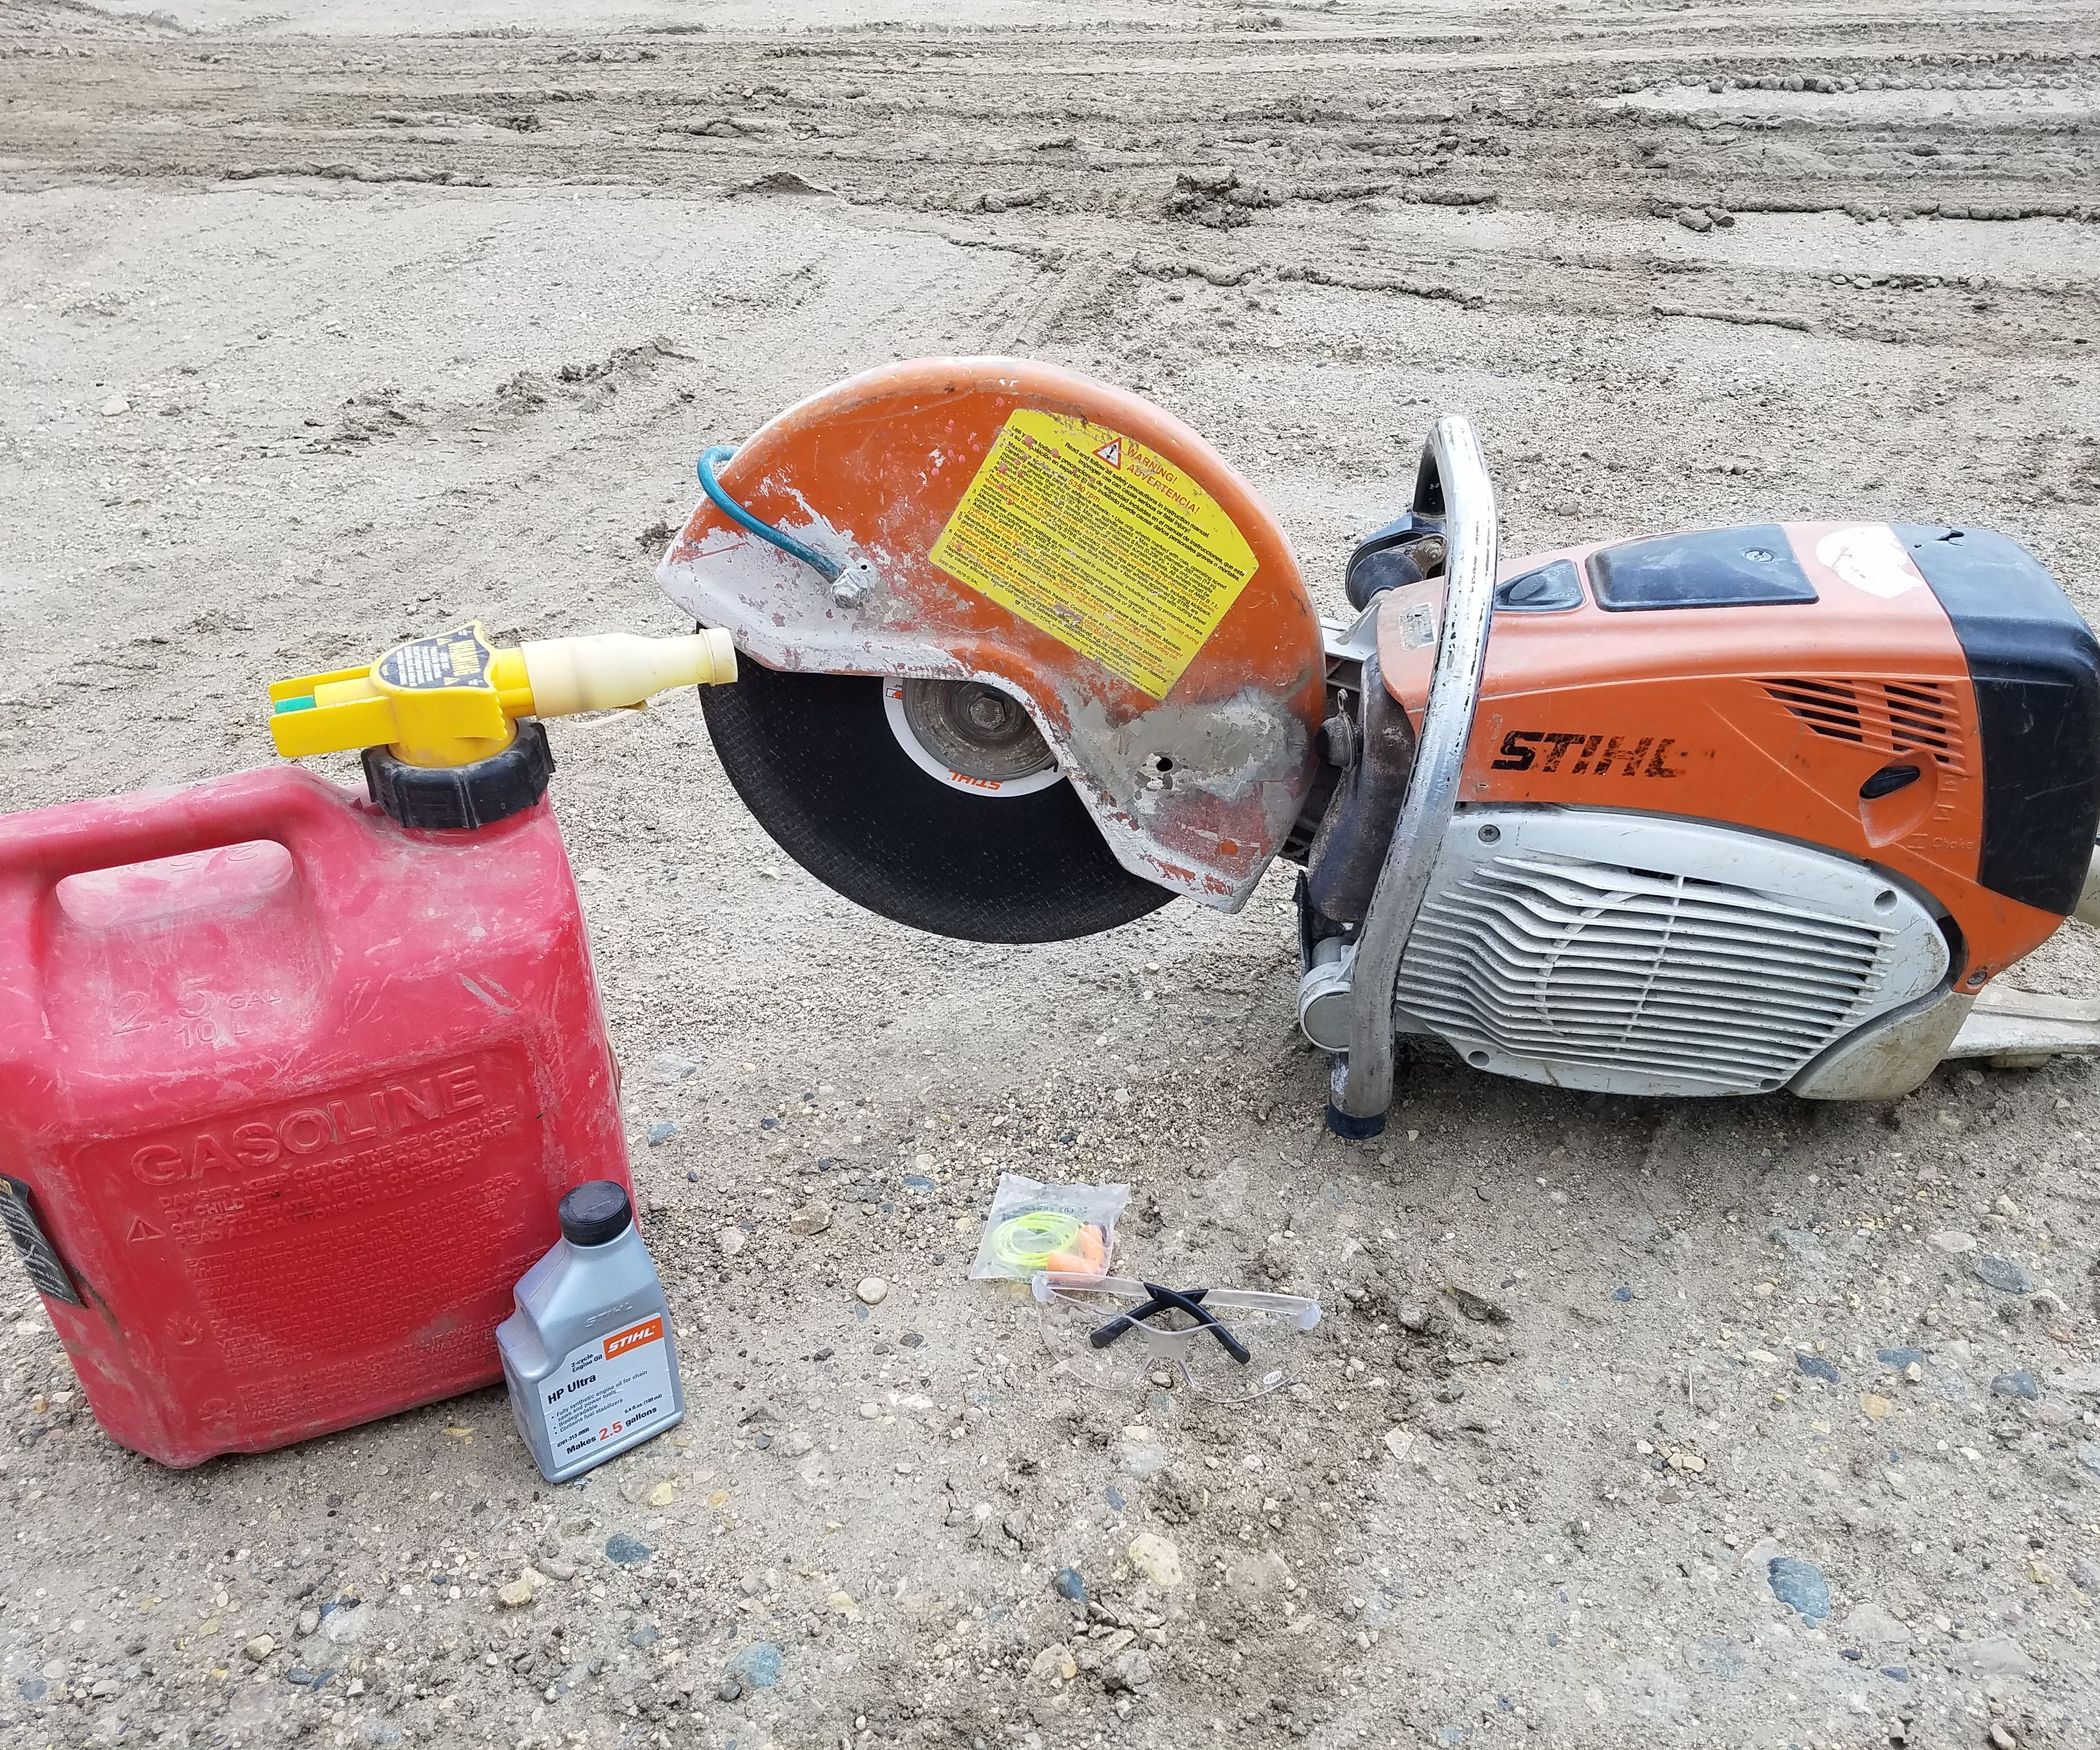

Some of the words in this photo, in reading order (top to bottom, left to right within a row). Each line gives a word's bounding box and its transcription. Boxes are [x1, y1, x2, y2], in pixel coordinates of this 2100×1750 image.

[1127, 446, 1178, 485] WARNING!
[1064, 442, 1079, 454] Read
[1078, 451, 1089, 461] and
[1088, 458, 1106, 471] follow
[1104, 467, 1113, 476] all
[1111, 472, 1128, 485] safety
[1127, 482, 1158, 505] precautions
[1163, 505, 1191, 525] instruction
[1077, 458, 1101, 476] Improper
[1101, 473, 1112, 483] use
[1111, 480, 1121, 489] can
[1121, 486, 1138, 499] cause
[1137, 496, 1157, 511] serious
[1162, 512, 1174, 523] fatal
[1173, 520, 1190, 533] injury!
[1126, 463, 1201, 515] ADVERTENCIA!
[947, 768, 1004, 791] STIHL
[131, 1065, 484, 1186] GASOLINE
[460, 1120, 511, 1147] START
[242, 1172, 290, 1190] KEEP
[293, 1162, 328, 1181] OUT
[333, 1155, 356, 1171] OF
[358, 1144, 395, 1161] THE
[395, 1126, 452, 1149] REACH
[608, 1328, 655, 1354] STIHL
[571, 1353, 594, 1368] 2-cycle
[572, 1360, 593, 1373] Engine
[593, 1354, 603, 1362] Oil
[547, 1388, 565, 1405] HP
[567, 1374, 597, 1393] Ultra
[556, 1407, 569, 1418] Fully
[569, 1393, 594, 1409] synthetic
[595, 1386, 615, 1398] engine
[623, 1376, 632, 1384] for
[632, 1370, 648, 1380] chain
[557, 1411, 572, 1422] saws
[572, 1405, 584, 1414] and
[584, 1397, 602, 1410] power
[558, 1404, 598, 1427] Biodegradable
[560, 1417, 583, 1433] Contains
[583, 1411, 594, 1420] fuel
[595, 1398, 624, 1415] stabilizers
[566, 1436, 597, 1454] Makes
[598, 1421, 623, 1441] 2.5
[625, 1407, 658, 1427] gallons
